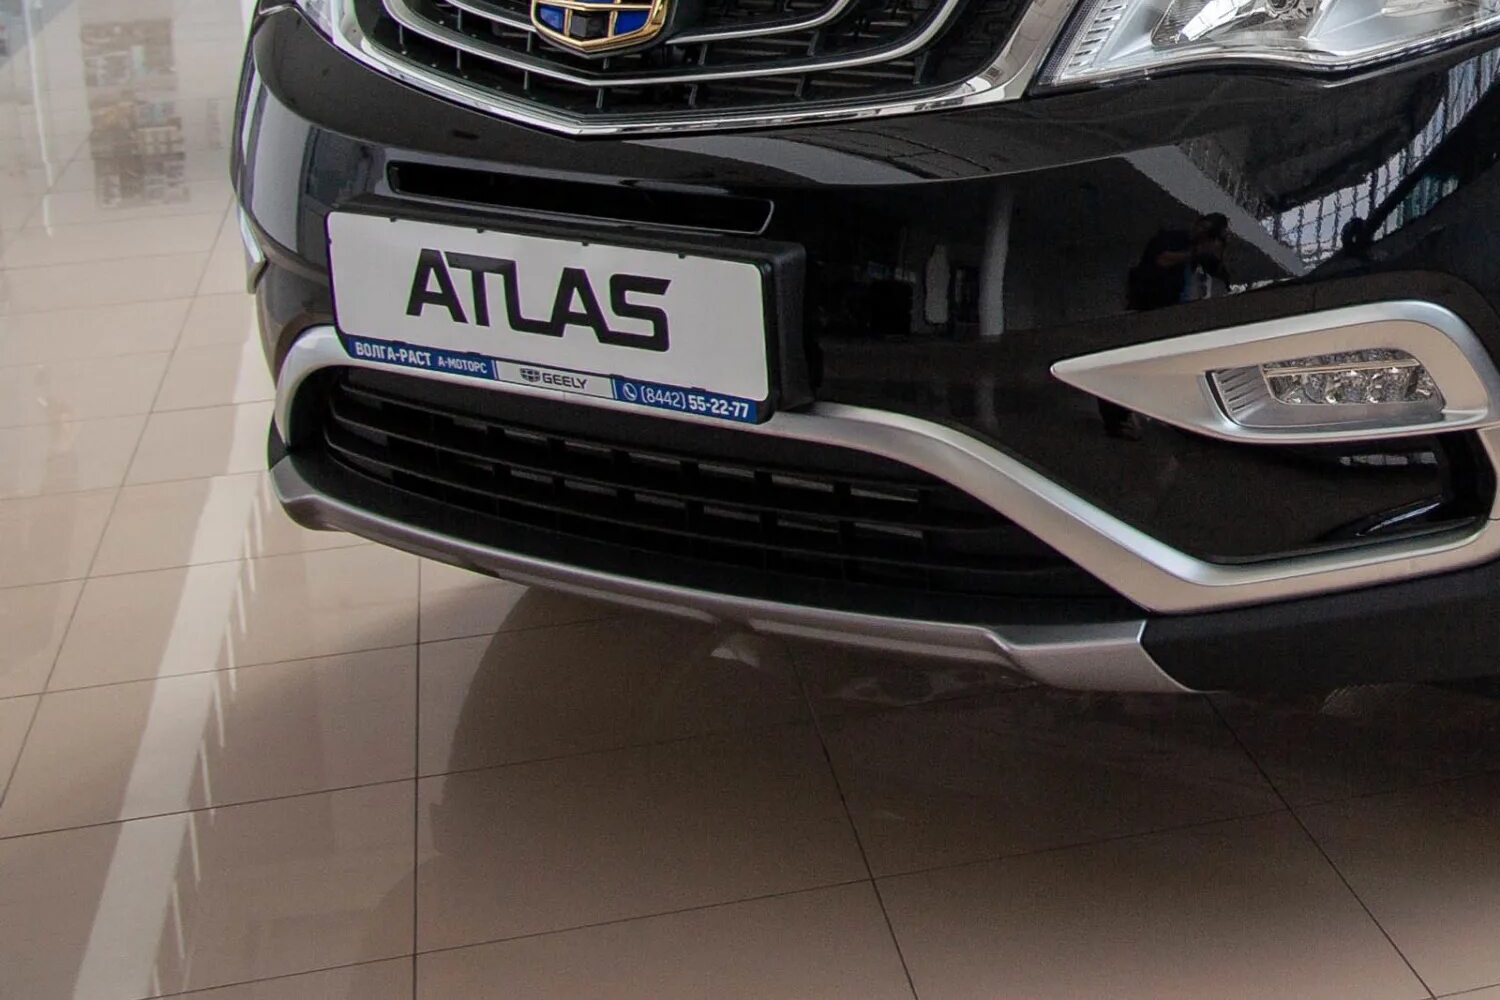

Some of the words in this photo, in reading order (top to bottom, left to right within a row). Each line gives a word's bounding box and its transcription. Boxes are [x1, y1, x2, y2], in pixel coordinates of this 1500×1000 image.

[406, 248, 672, 353] ATLAS
[355, 341, 432, 366] ВОЛГА-РАСТ
[437, 356, 488, 374] А-МОТОРС
[542, 372, 587, 390] GEELY
[640, 384, 686, 409] (8442)
[687, 394, 750, 419] 55-22-77
